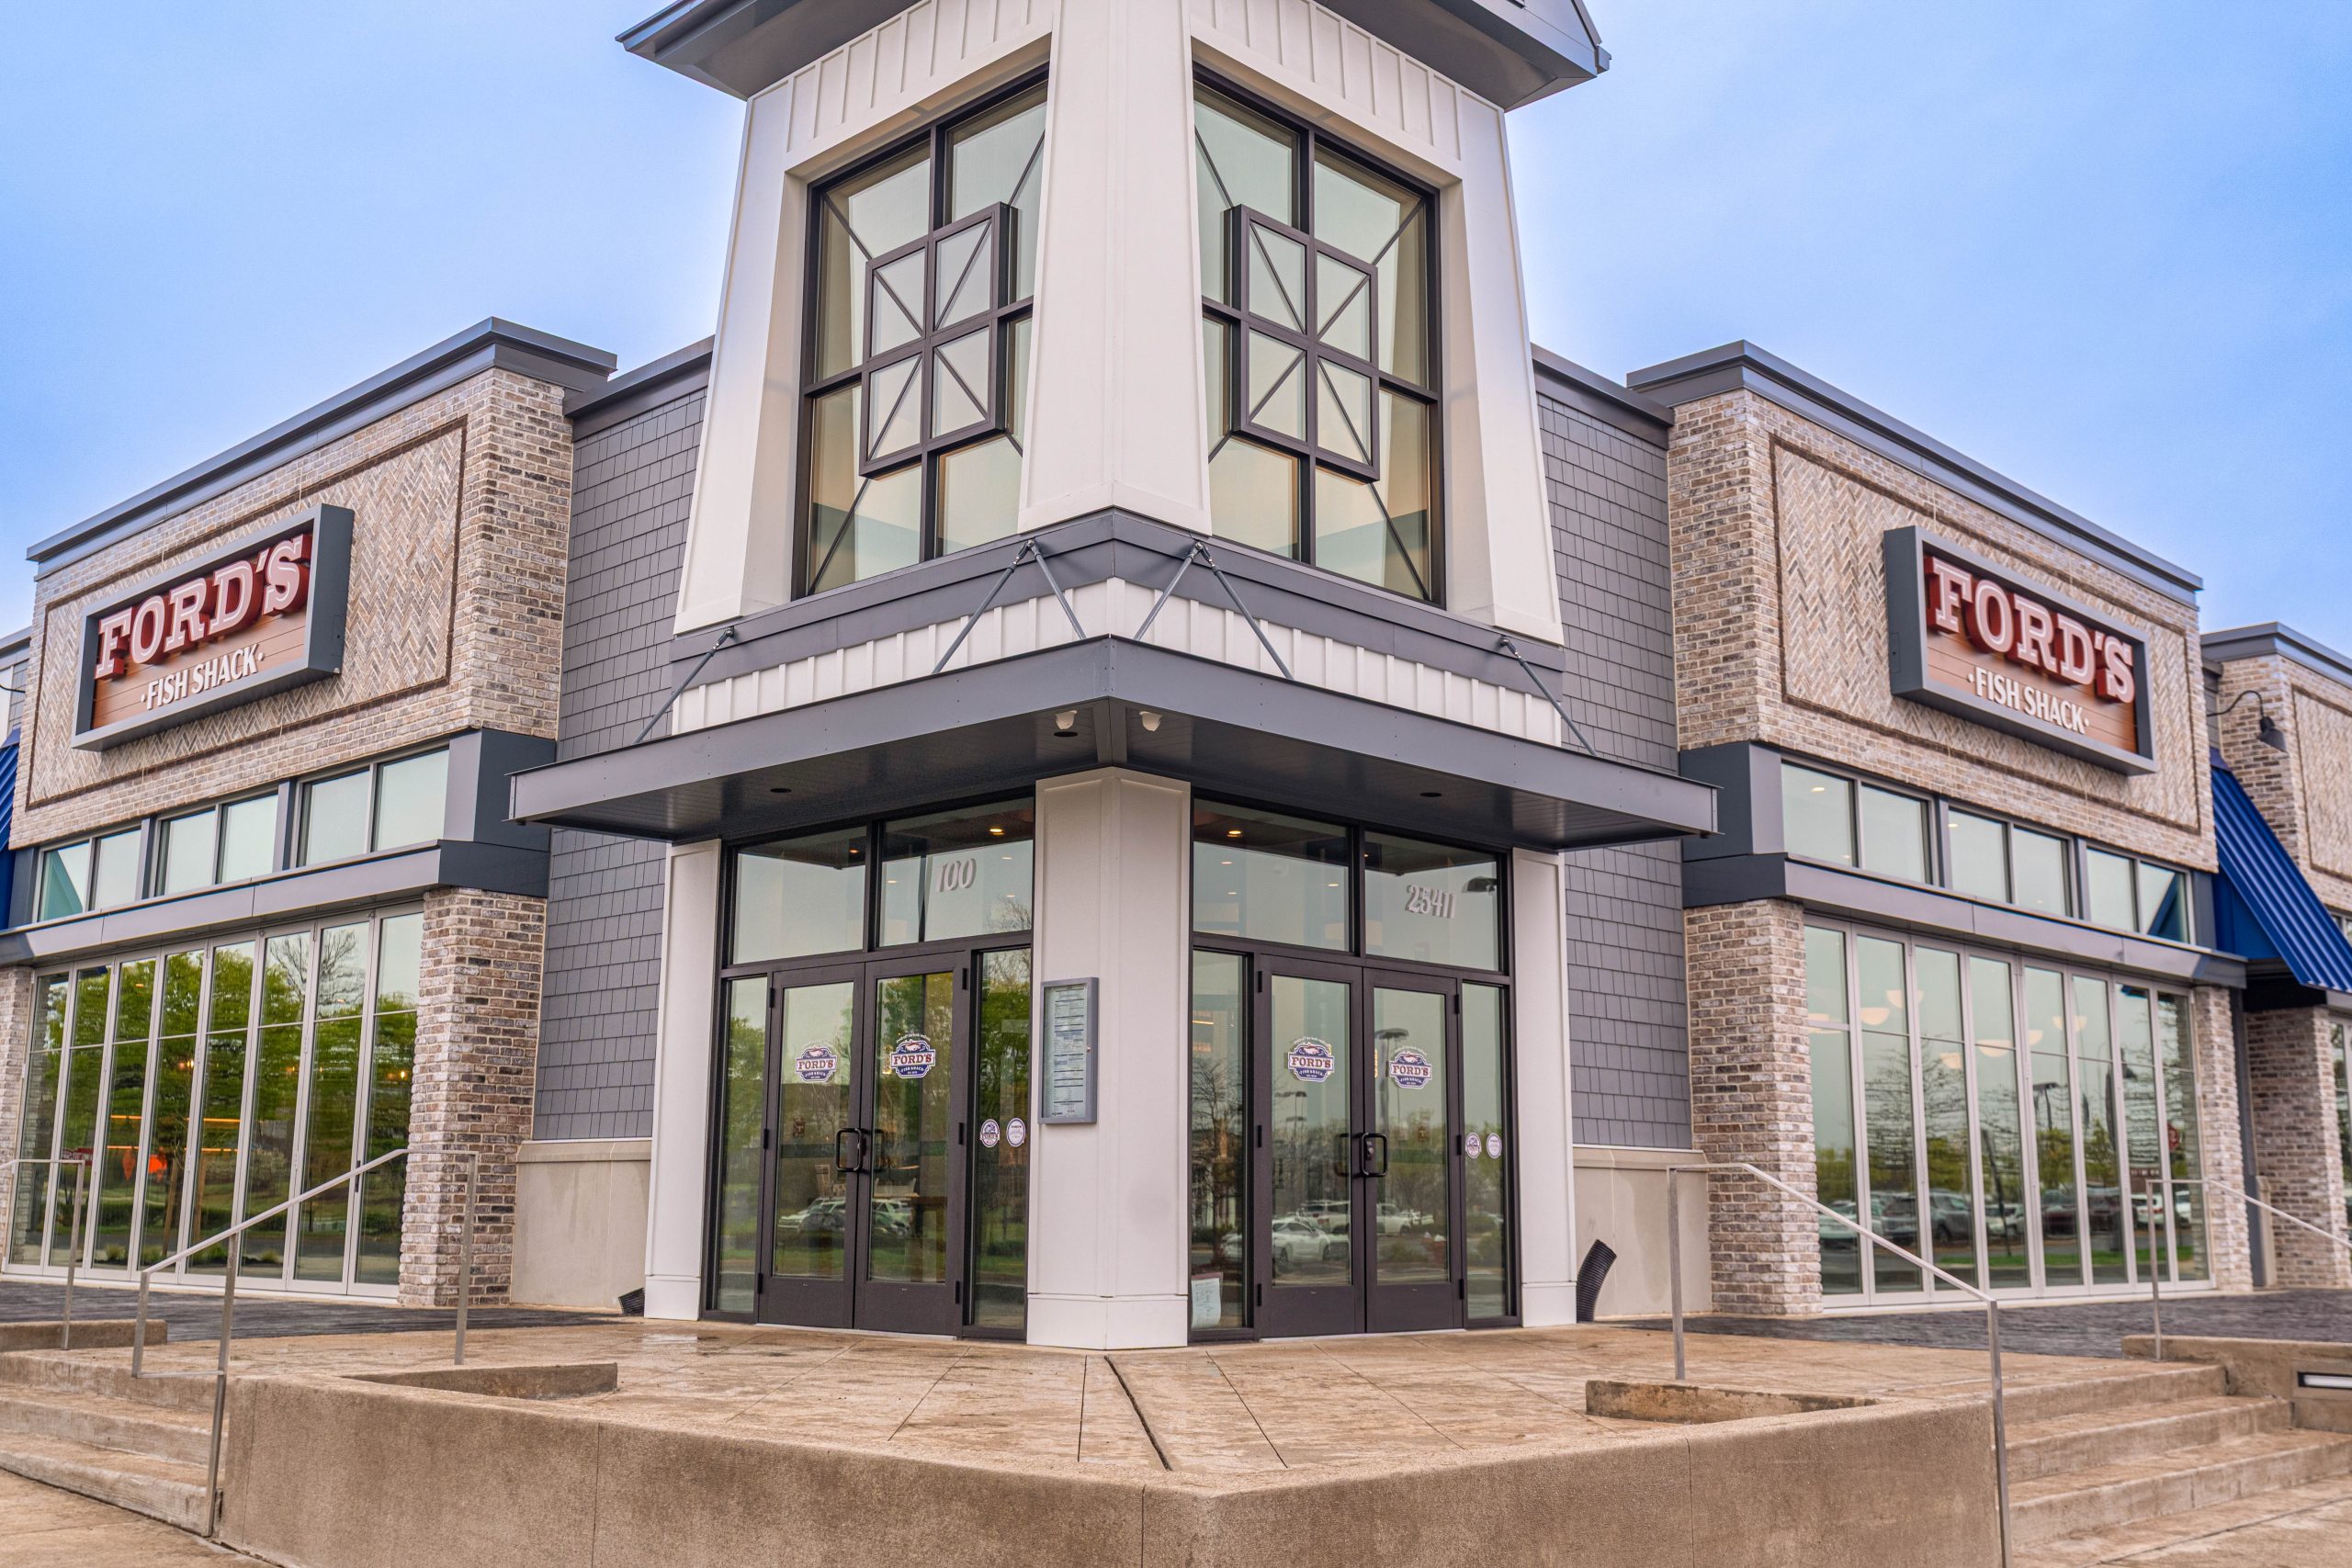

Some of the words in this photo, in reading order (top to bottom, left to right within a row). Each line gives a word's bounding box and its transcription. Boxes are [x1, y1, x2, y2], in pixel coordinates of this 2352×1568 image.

[95, 534, 305, 680] FORD'S
[1933, 557, 2136, 705] FORD'S
[146, 668, 189, 710] FISH
[191, 644, 259, 694] SHACK
[1975, 666, 2021, 712] FISH
[2023, 685, 2086, 735] SHACK
[935, 858, 977, 893] 100
[1405, 885, 1457, 919] 25411
[797, 1059, 834, 1070] FORD'S
[893, 1054, 933, 1066] FORD'S
[1291, 1056, 1331, 1068] FORD'S
[1392, 1065, 1429, 1076] FORD'S
